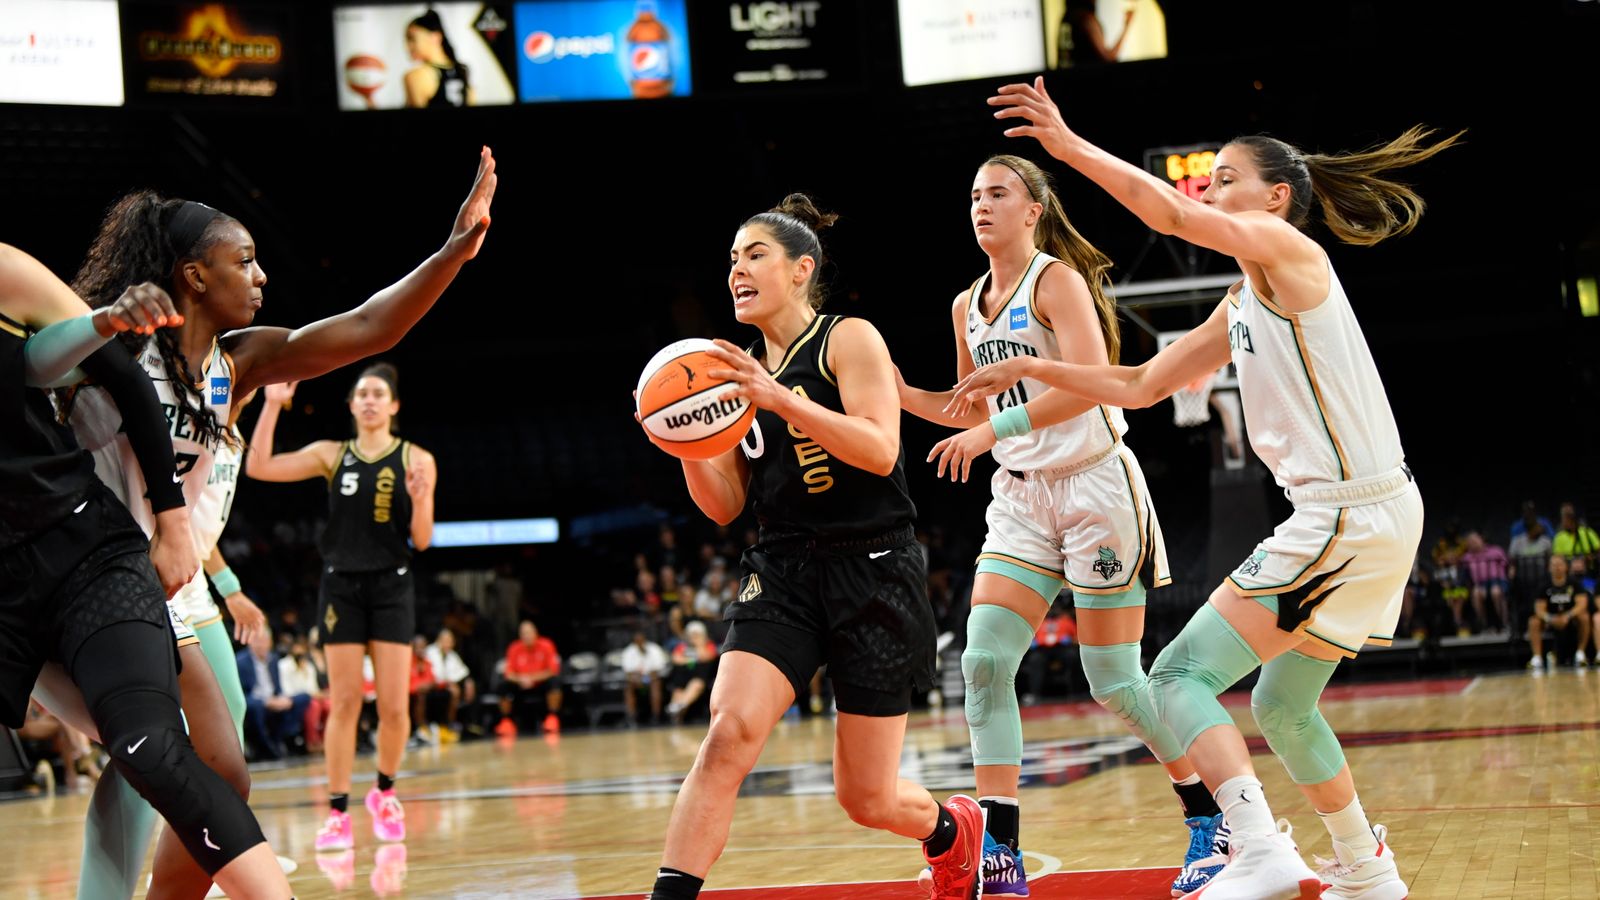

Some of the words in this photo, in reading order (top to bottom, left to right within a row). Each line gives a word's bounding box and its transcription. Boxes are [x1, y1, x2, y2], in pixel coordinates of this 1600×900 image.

[730, 1, 821, 31] LIGHT
[554, 32, 614, 59] pepsi
[1166, 151, 1214, 180] 6:00
[1012, 313, 1027, 324] HSS
[664, 397, 743, 430] Wilson
[340, 472, 360, 496] 5
[374, 466, 396, 523] ACES
